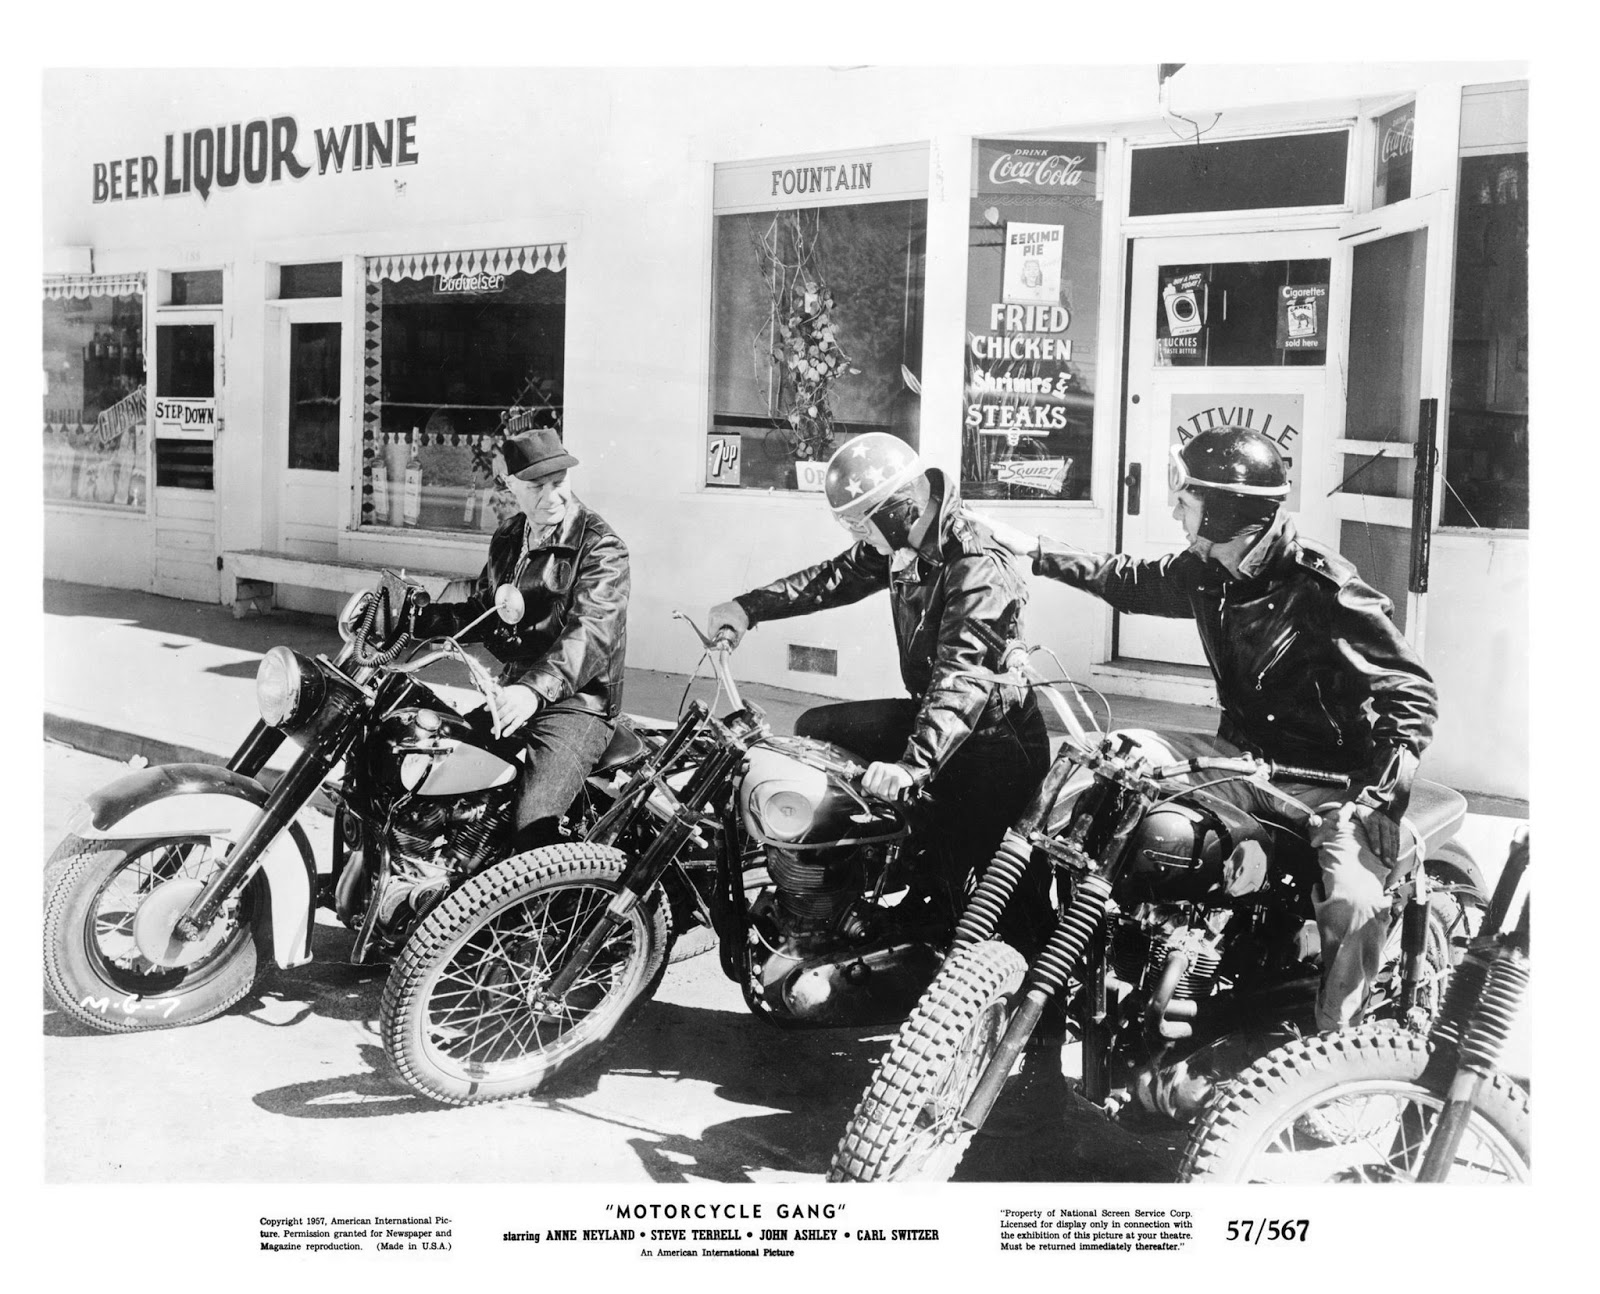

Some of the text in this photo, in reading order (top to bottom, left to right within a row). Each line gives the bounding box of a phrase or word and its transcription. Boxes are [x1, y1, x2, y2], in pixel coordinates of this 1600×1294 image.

[92, 114, 419, 204] BEER LIQUOR WINE
[989, 153, 1087, 186] Coca-Cola
[771, 162, 873, 196] FOUNTAIN
[1010, 230, 1060, 246] ESKIMO
[1023, 244, 1044, 256] PIE
[1282, 286, 1326, 299] Cigarettes
[990, 303, 1070, 333] FRIED
[1290, 305, 1312, 313] CAMEL
[971, 336, 1072, 361] CHICKEN
[1164, 337, 1198, 348] LUCKIES
[1285, 339, 1319, 347] sold here
[965, 404, 1067, 429] STEAKS
[1176, 407, 1298, 451] ATTVILLE
[804, 467, 826, 486] OP
